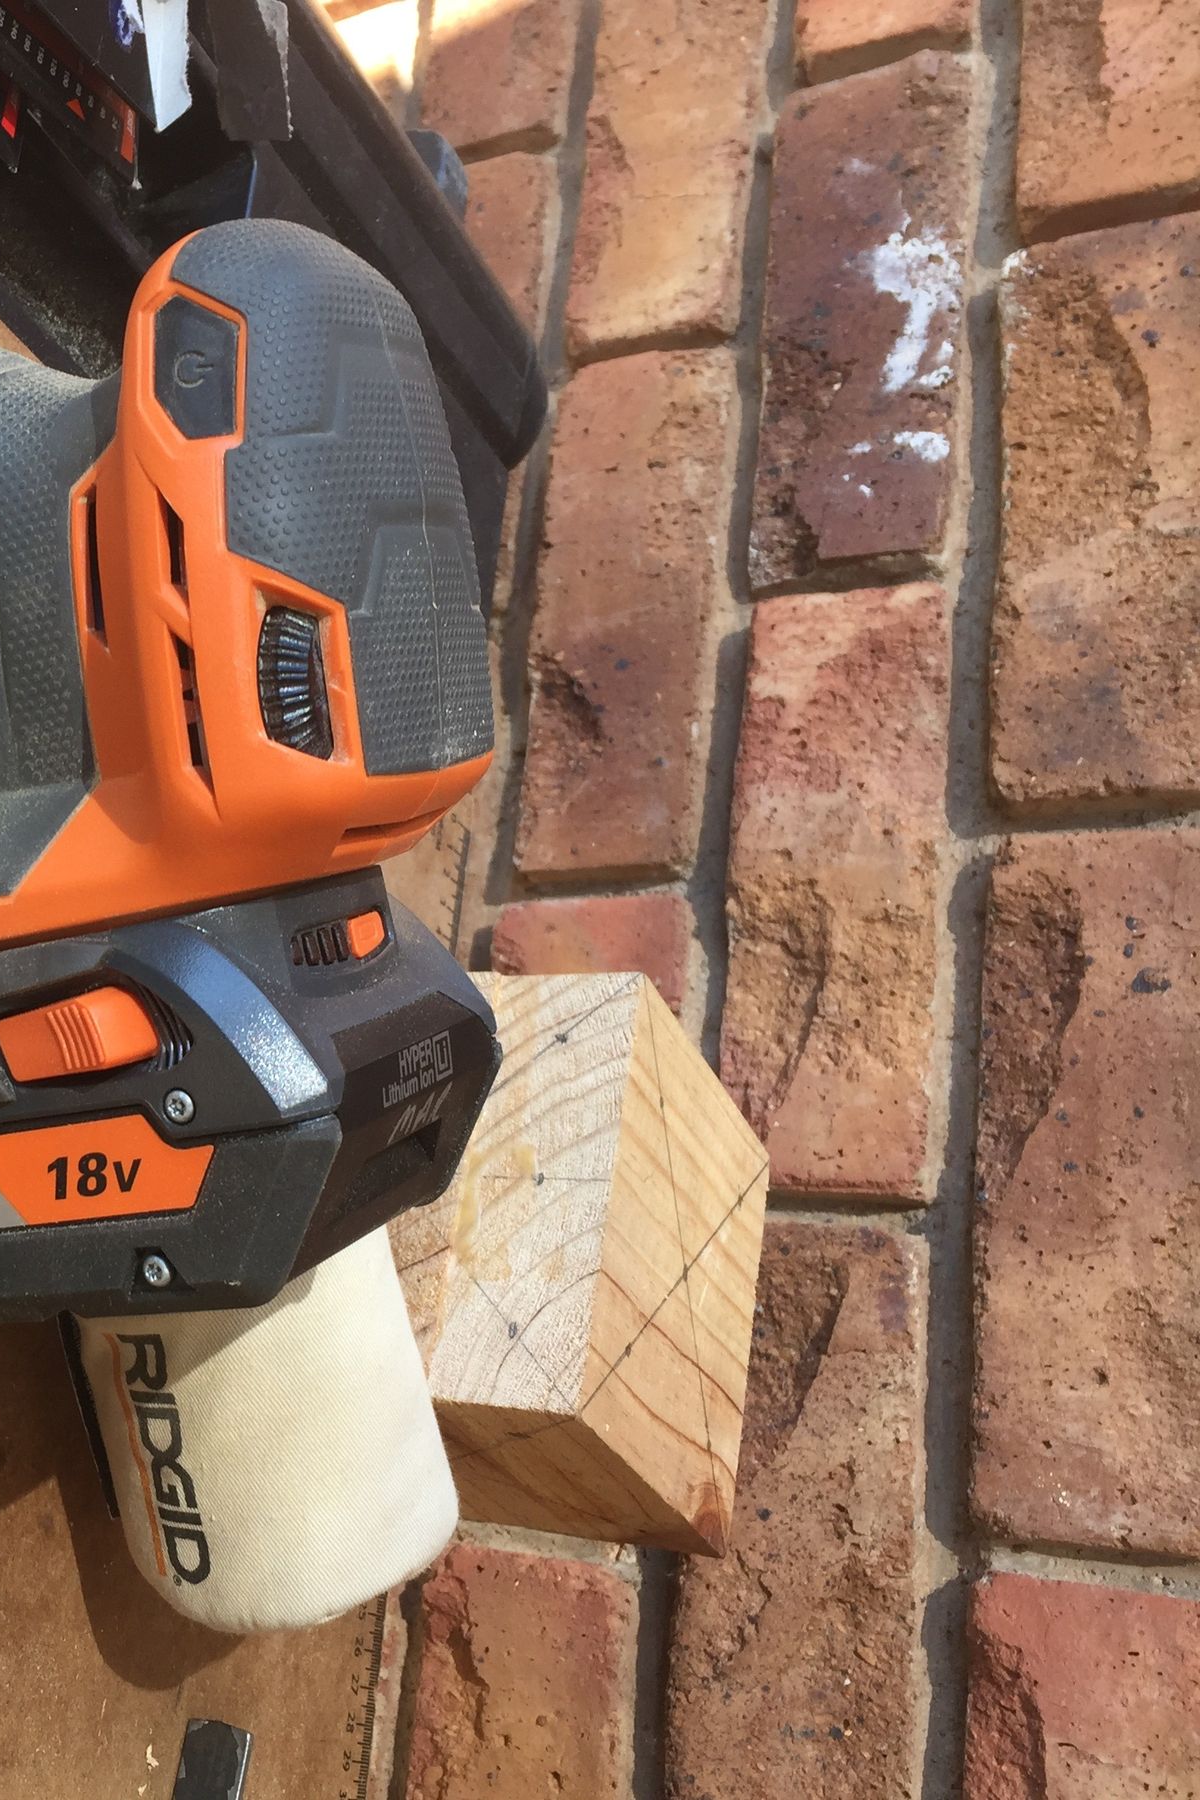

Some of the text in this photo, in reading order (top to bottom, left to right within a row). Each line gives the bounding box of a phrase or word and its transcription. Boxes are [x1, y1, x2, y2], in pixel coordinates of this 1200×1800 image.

[398, 1038, 434, 1078] HYPER
[382, 1068, 435, 1109] Lithium Ion
[115, 1333, 211, 1585] RIDGID
[354, 1636, 364, 1657] 26
[351, 1673, 360, 1697] 27
[342, 1749, 352, 1772] 29
